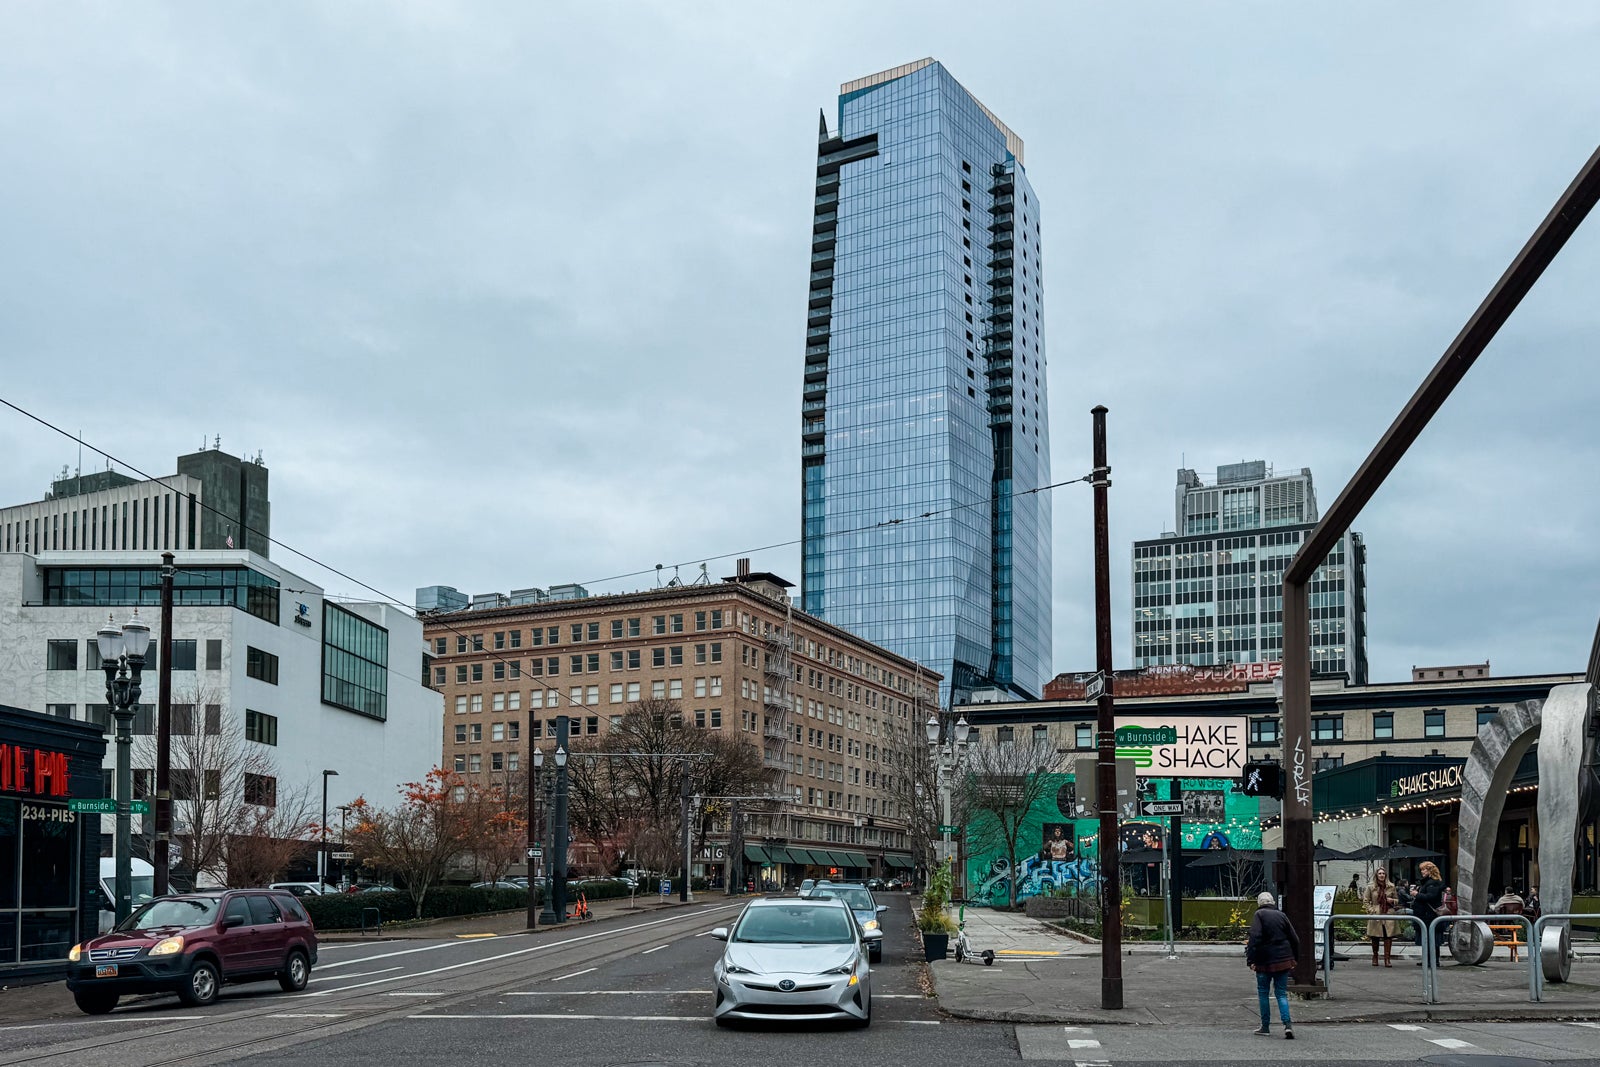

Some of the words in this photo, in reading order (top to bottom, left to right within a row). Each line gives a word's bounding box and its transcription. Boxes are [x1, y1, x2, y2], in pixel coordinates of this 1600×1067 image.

[1127, 731, 1167, 742] Burnside
[1159, 725, 1238, 745] HAKE
[1158, 747, 1242, 769] SHACK
[34, 748, 73, 797] PIE
[1398, 772, 1428, 797] SHAKE
[1428, 765, 1463, 791] SHACK
[22, 805, 76, 823] 234-PIES
[77, 801, 110, 811] Burnside
